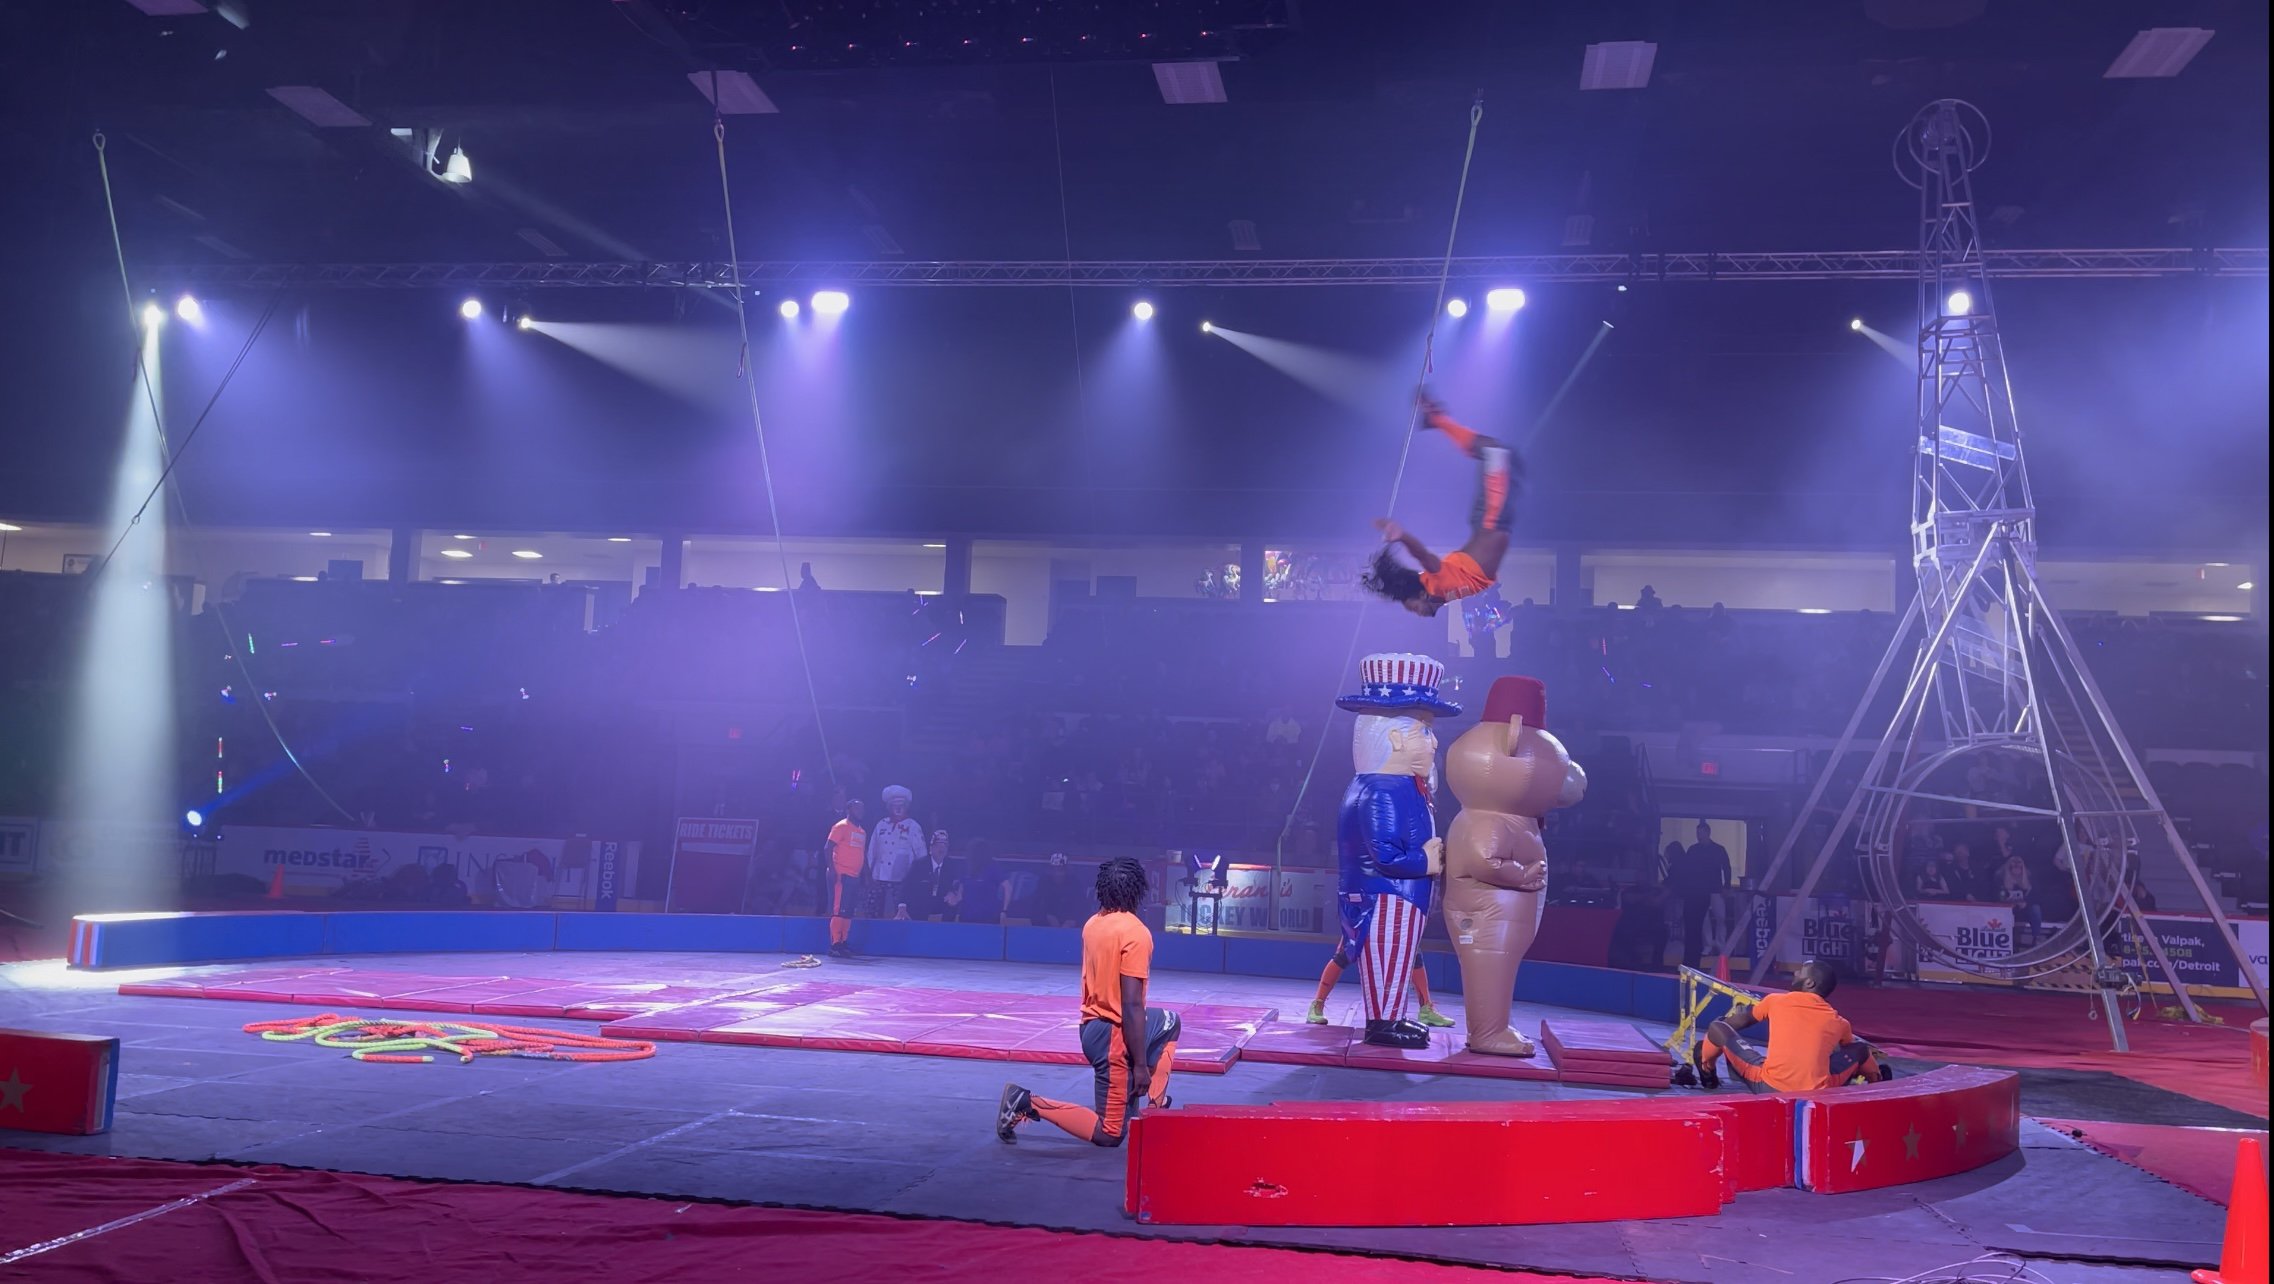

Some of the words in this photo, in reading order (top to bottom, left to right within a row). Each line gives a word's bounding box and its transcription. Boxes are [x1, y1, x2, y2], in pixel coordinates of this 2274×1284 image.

[680, 823, 706, 838] RIDE
[708, 823, 753, 840] TICKETS
[601, 841, 618, 900] Reebok
[1957, 926, 2010, 949] Blue
[2161, 934, 2206, 948] Valpak,
